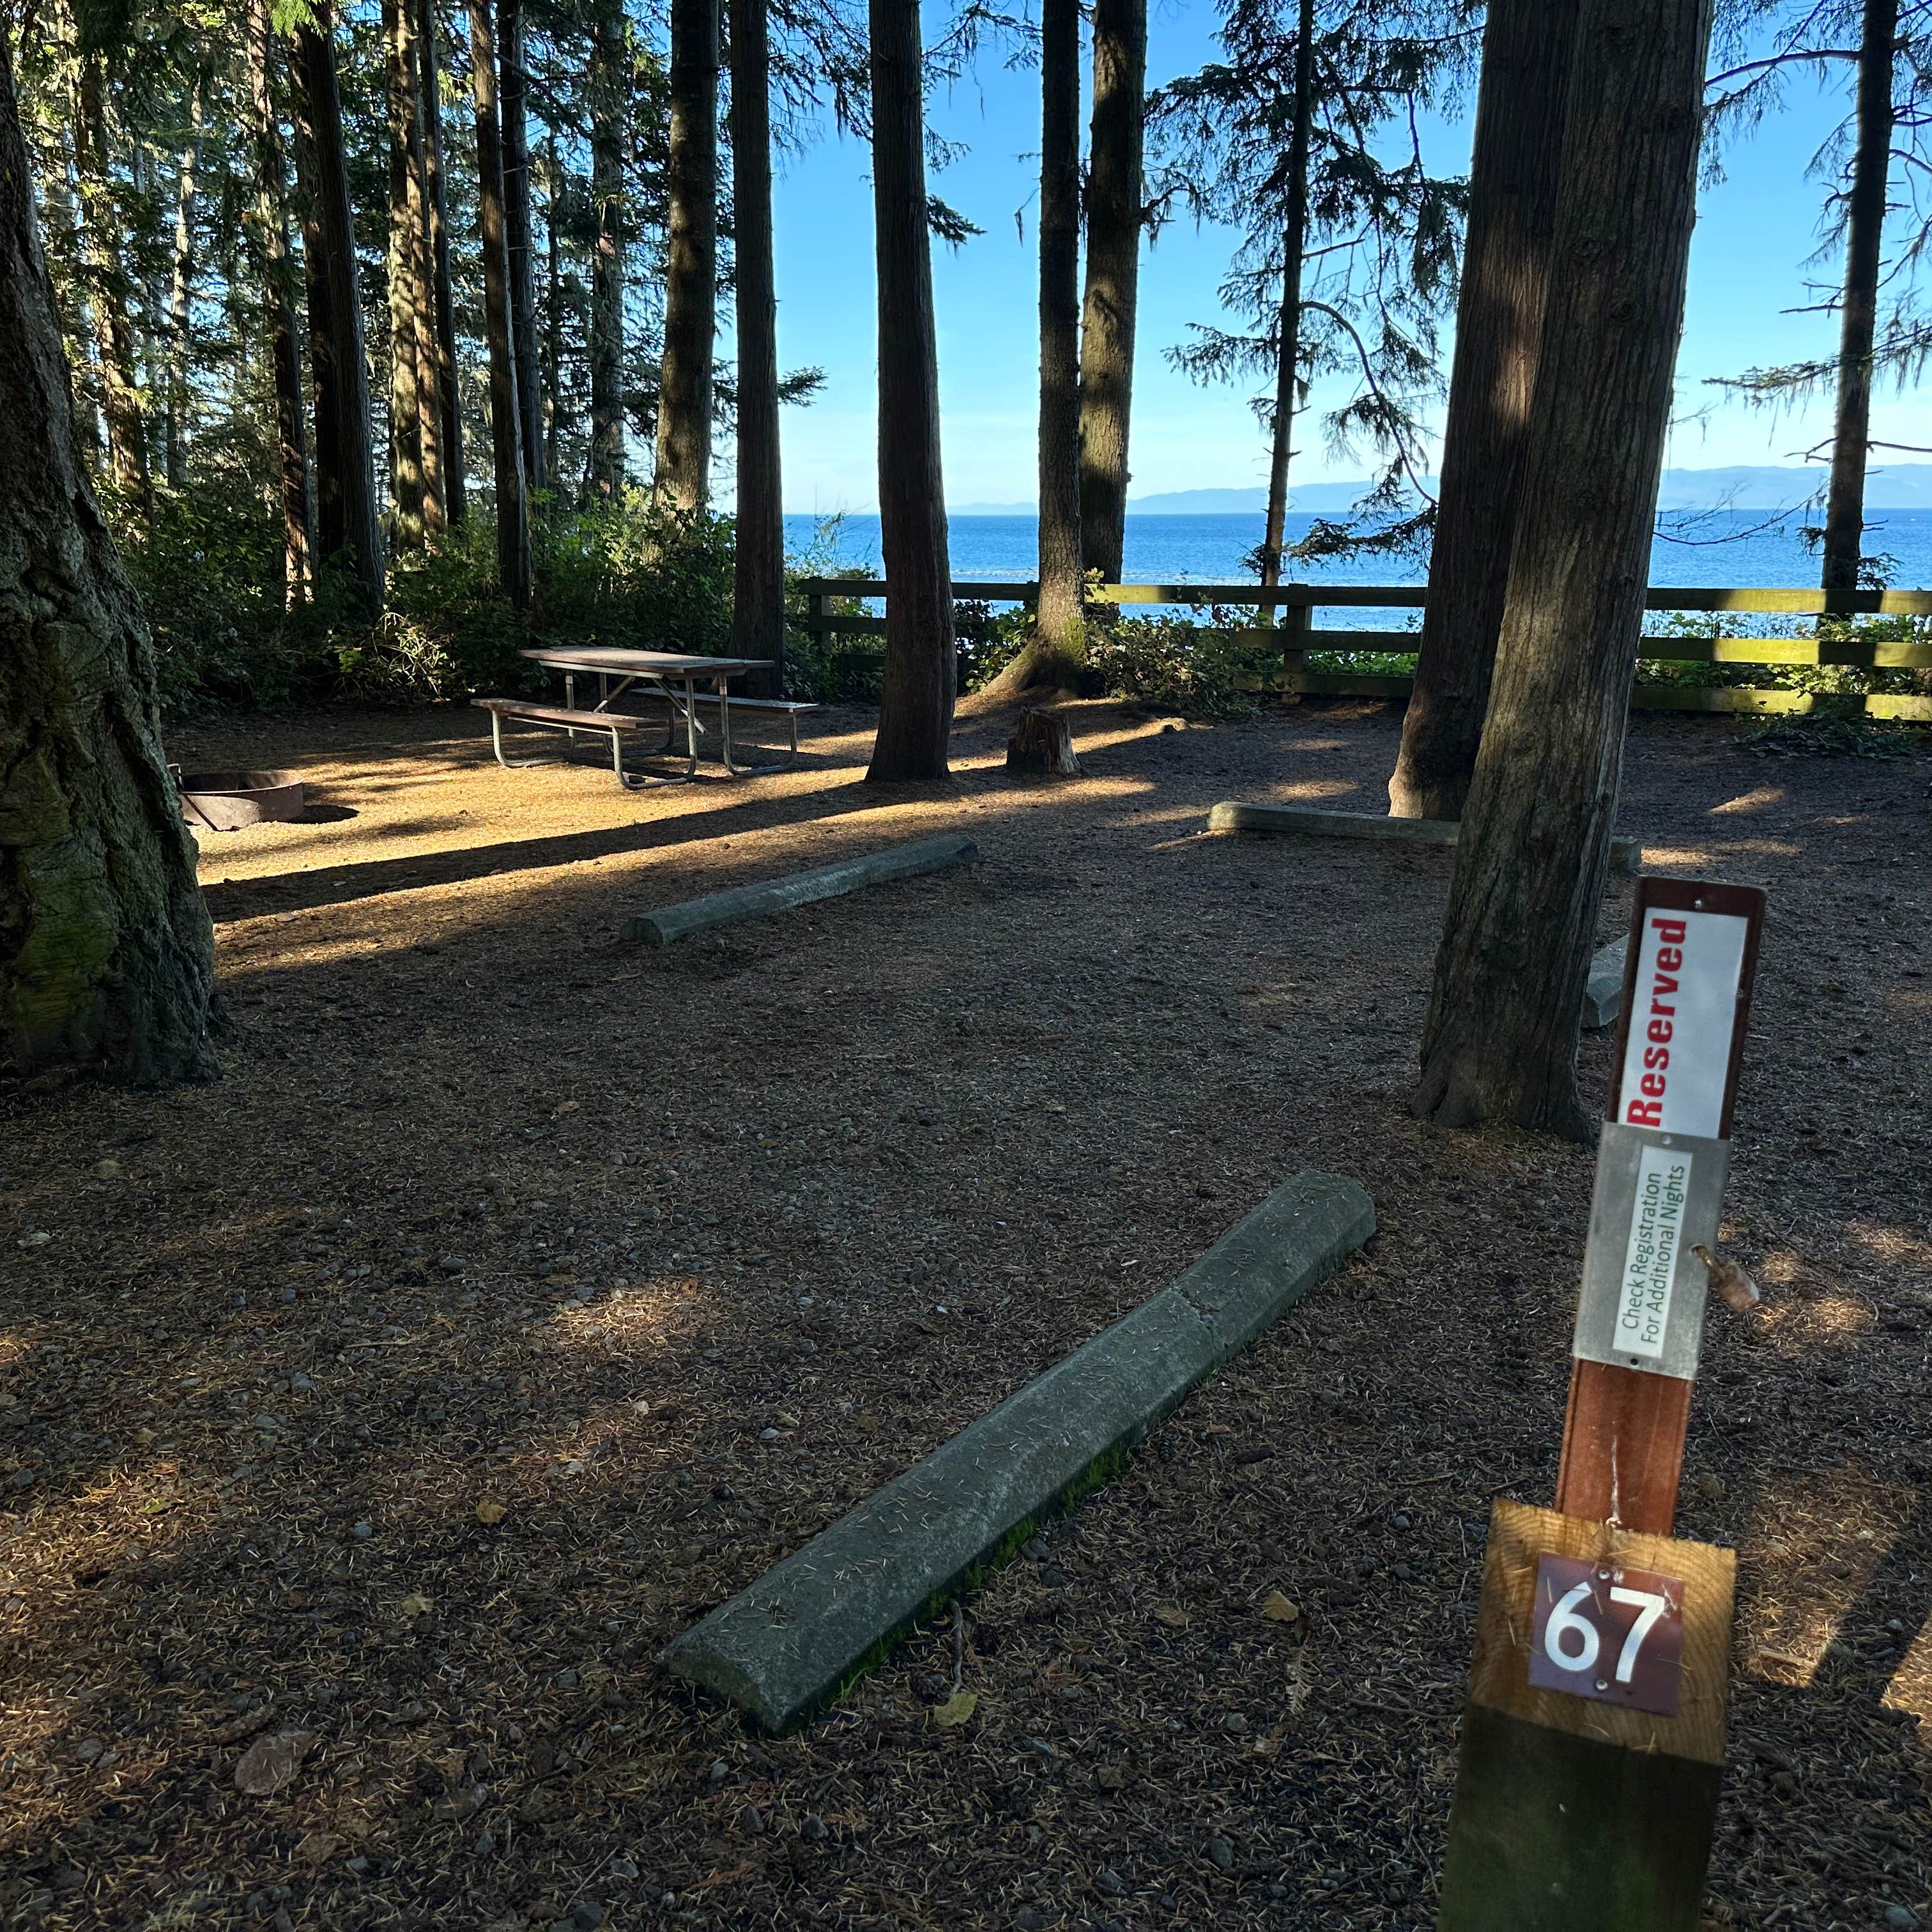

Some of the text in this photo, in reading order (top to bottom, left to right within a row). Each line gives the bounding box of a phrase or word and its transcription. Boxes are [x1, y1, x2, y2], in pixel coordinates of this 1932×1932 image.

[1627, 918, 1687, 1127] Reserved
[1622, 1173, 1662, 1330] Check Registration
[1641, 1165, 1685, 1344] For Additional Nights
[1544, 1581, 1664, 1683] 67
